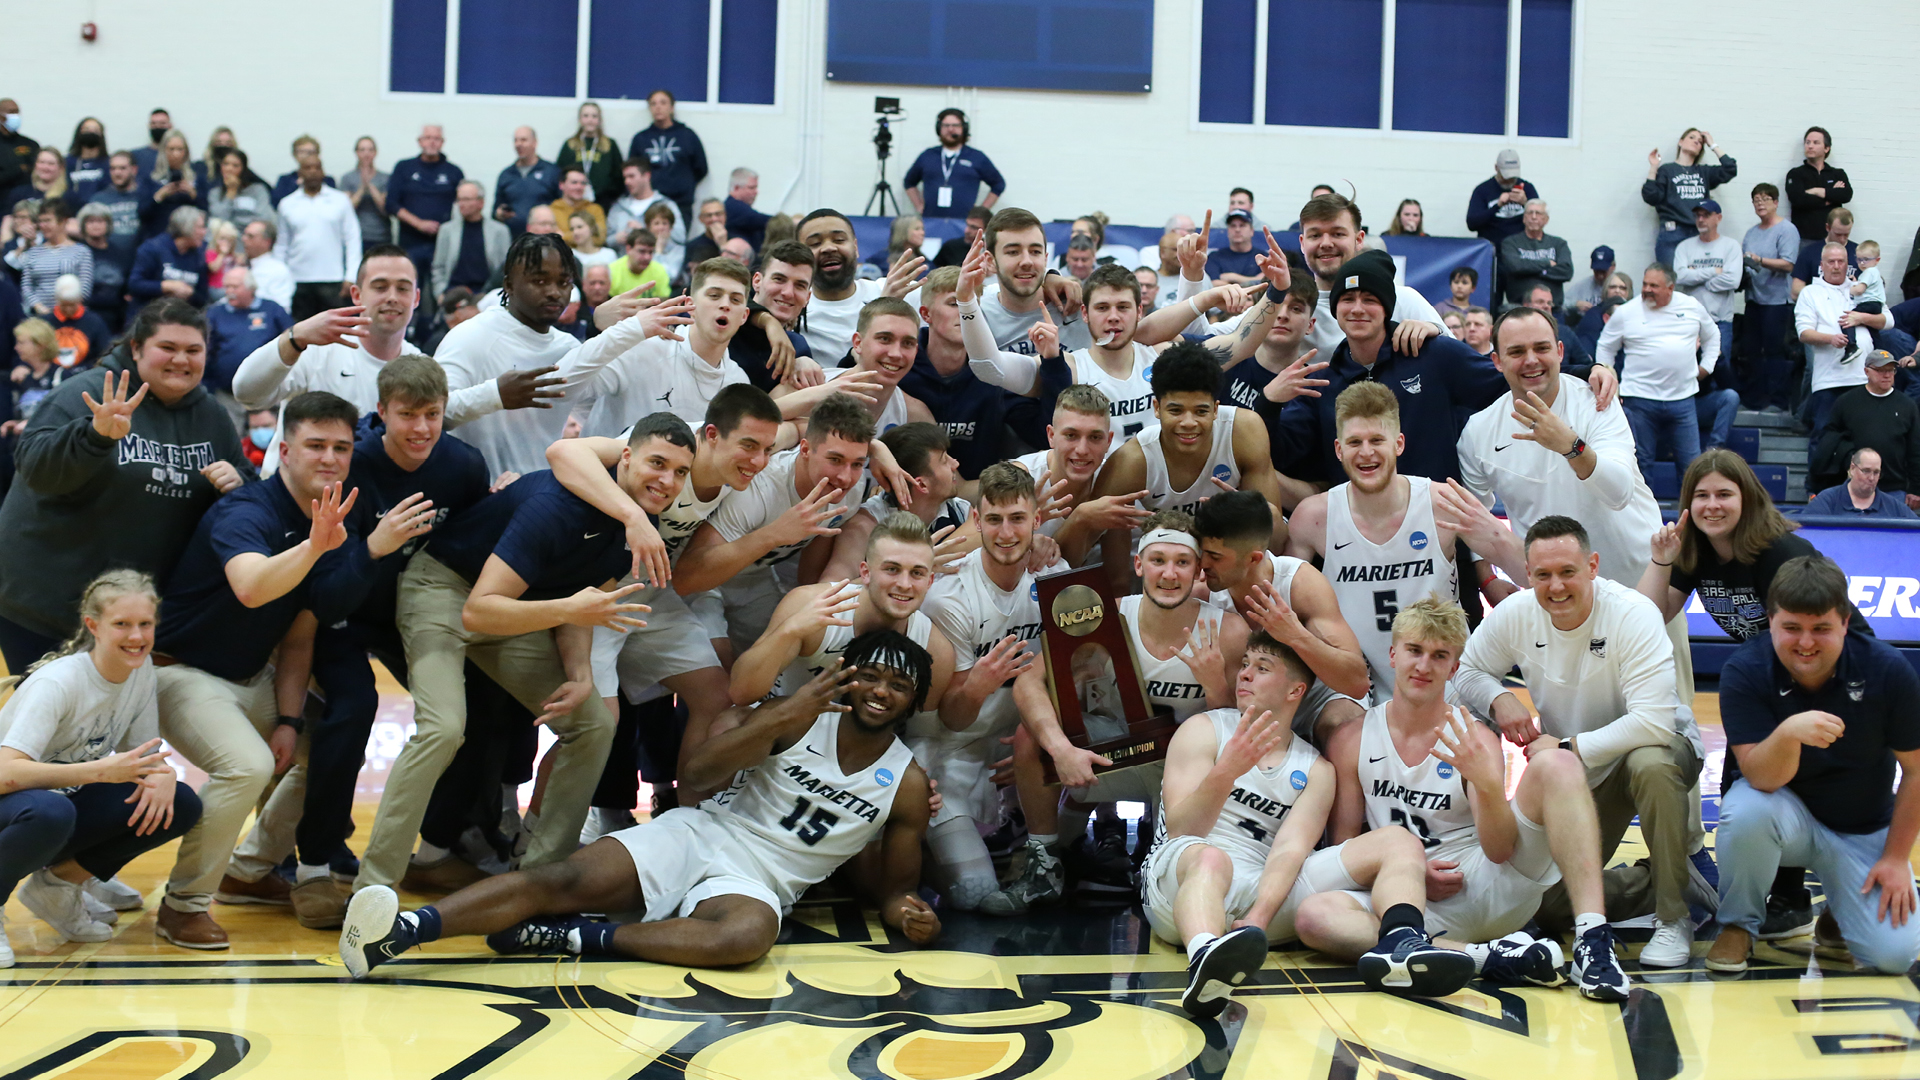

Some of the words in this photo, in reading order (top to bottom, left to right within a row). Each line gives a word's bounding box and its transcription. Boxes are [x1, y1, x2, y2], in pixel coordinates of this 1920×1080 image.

[1108, 393, 1155, 417] ARIET
[118, 433, 215, 472] MARIETTA
[1412, 538, 1427, 546] NCAA
[1336, 558, 1434, 582] MARIETTA
[1059, 604, 1103, 627] NCAA
[1373, 589, 1400, 632] 5
[1147, 680, 1206, 699] RIETT
[783, 764, 881, 823] MARIETTA
[1228, 787, 1292, 820] ARIET
[1371, 779, 1451, 810] MARIETTA
[778, 797, 841, 846] 15
